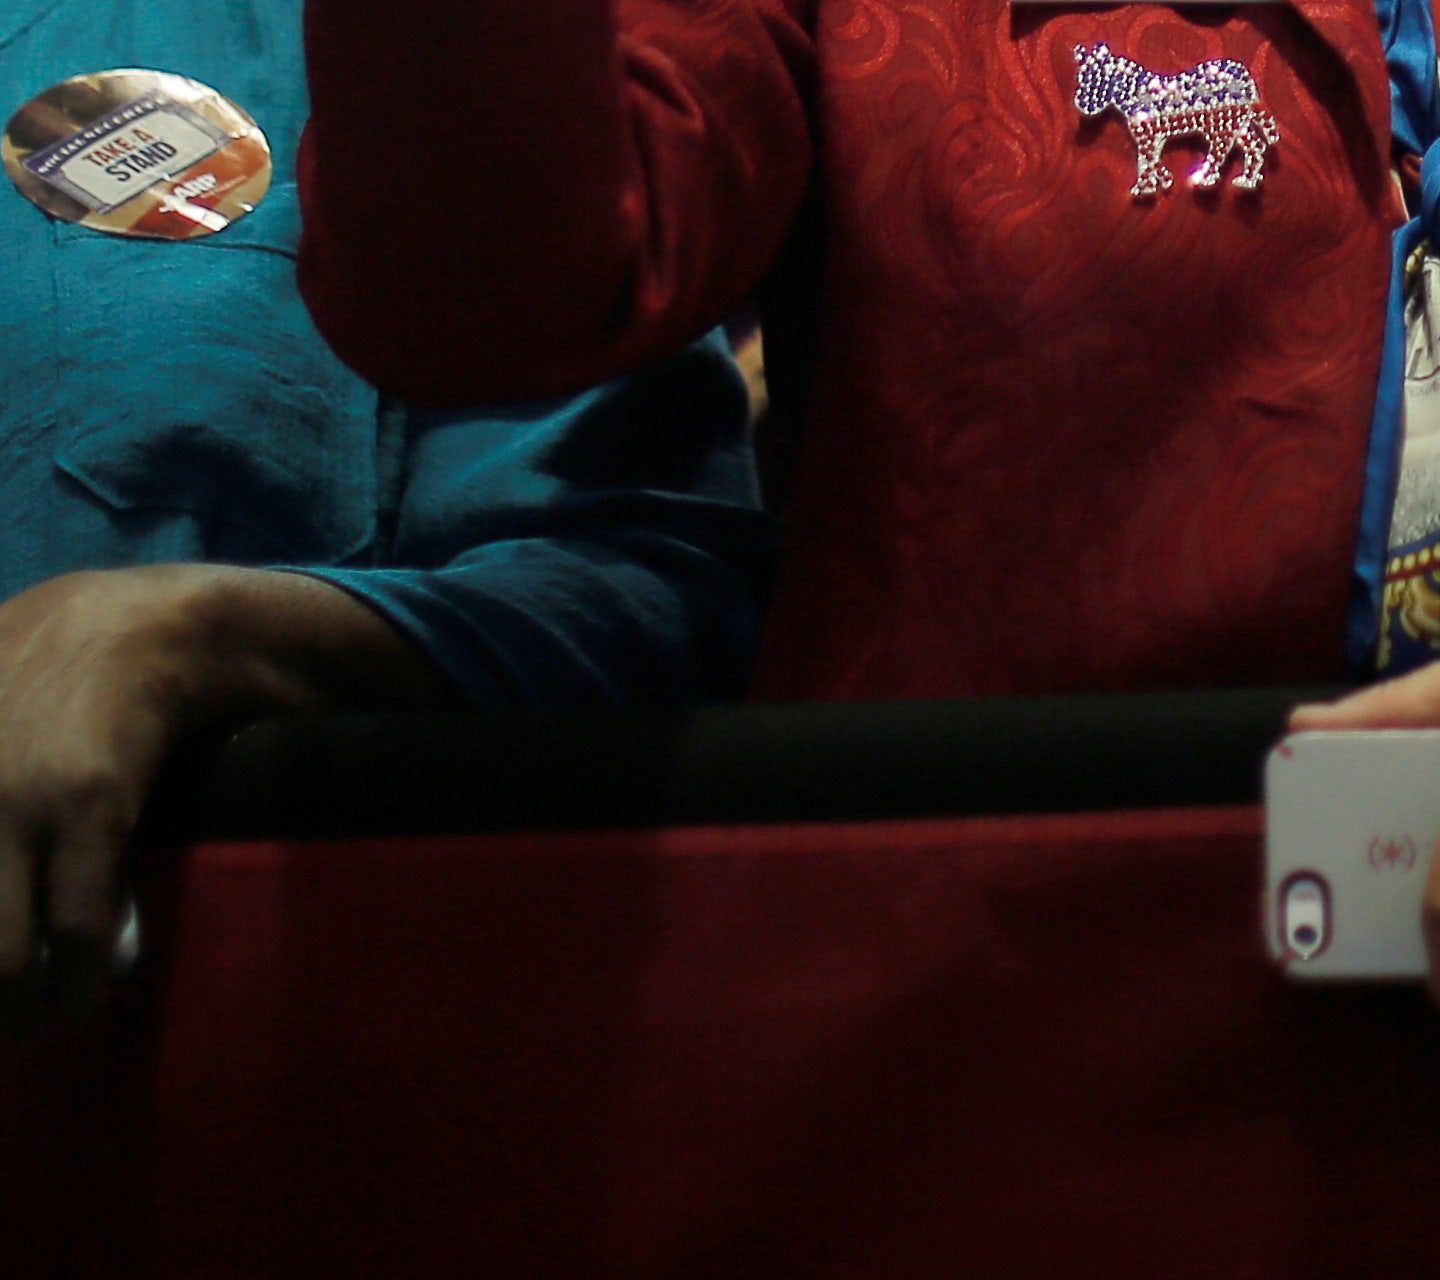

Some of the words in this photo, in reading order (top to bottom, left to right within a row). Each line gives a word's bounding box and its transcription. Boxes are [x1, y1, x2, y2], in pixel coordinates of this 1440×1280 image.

[81, 136, 135, 167] TAKE
[131, 128, 155, 142] A
[105, 142, 178, 183] STAND
